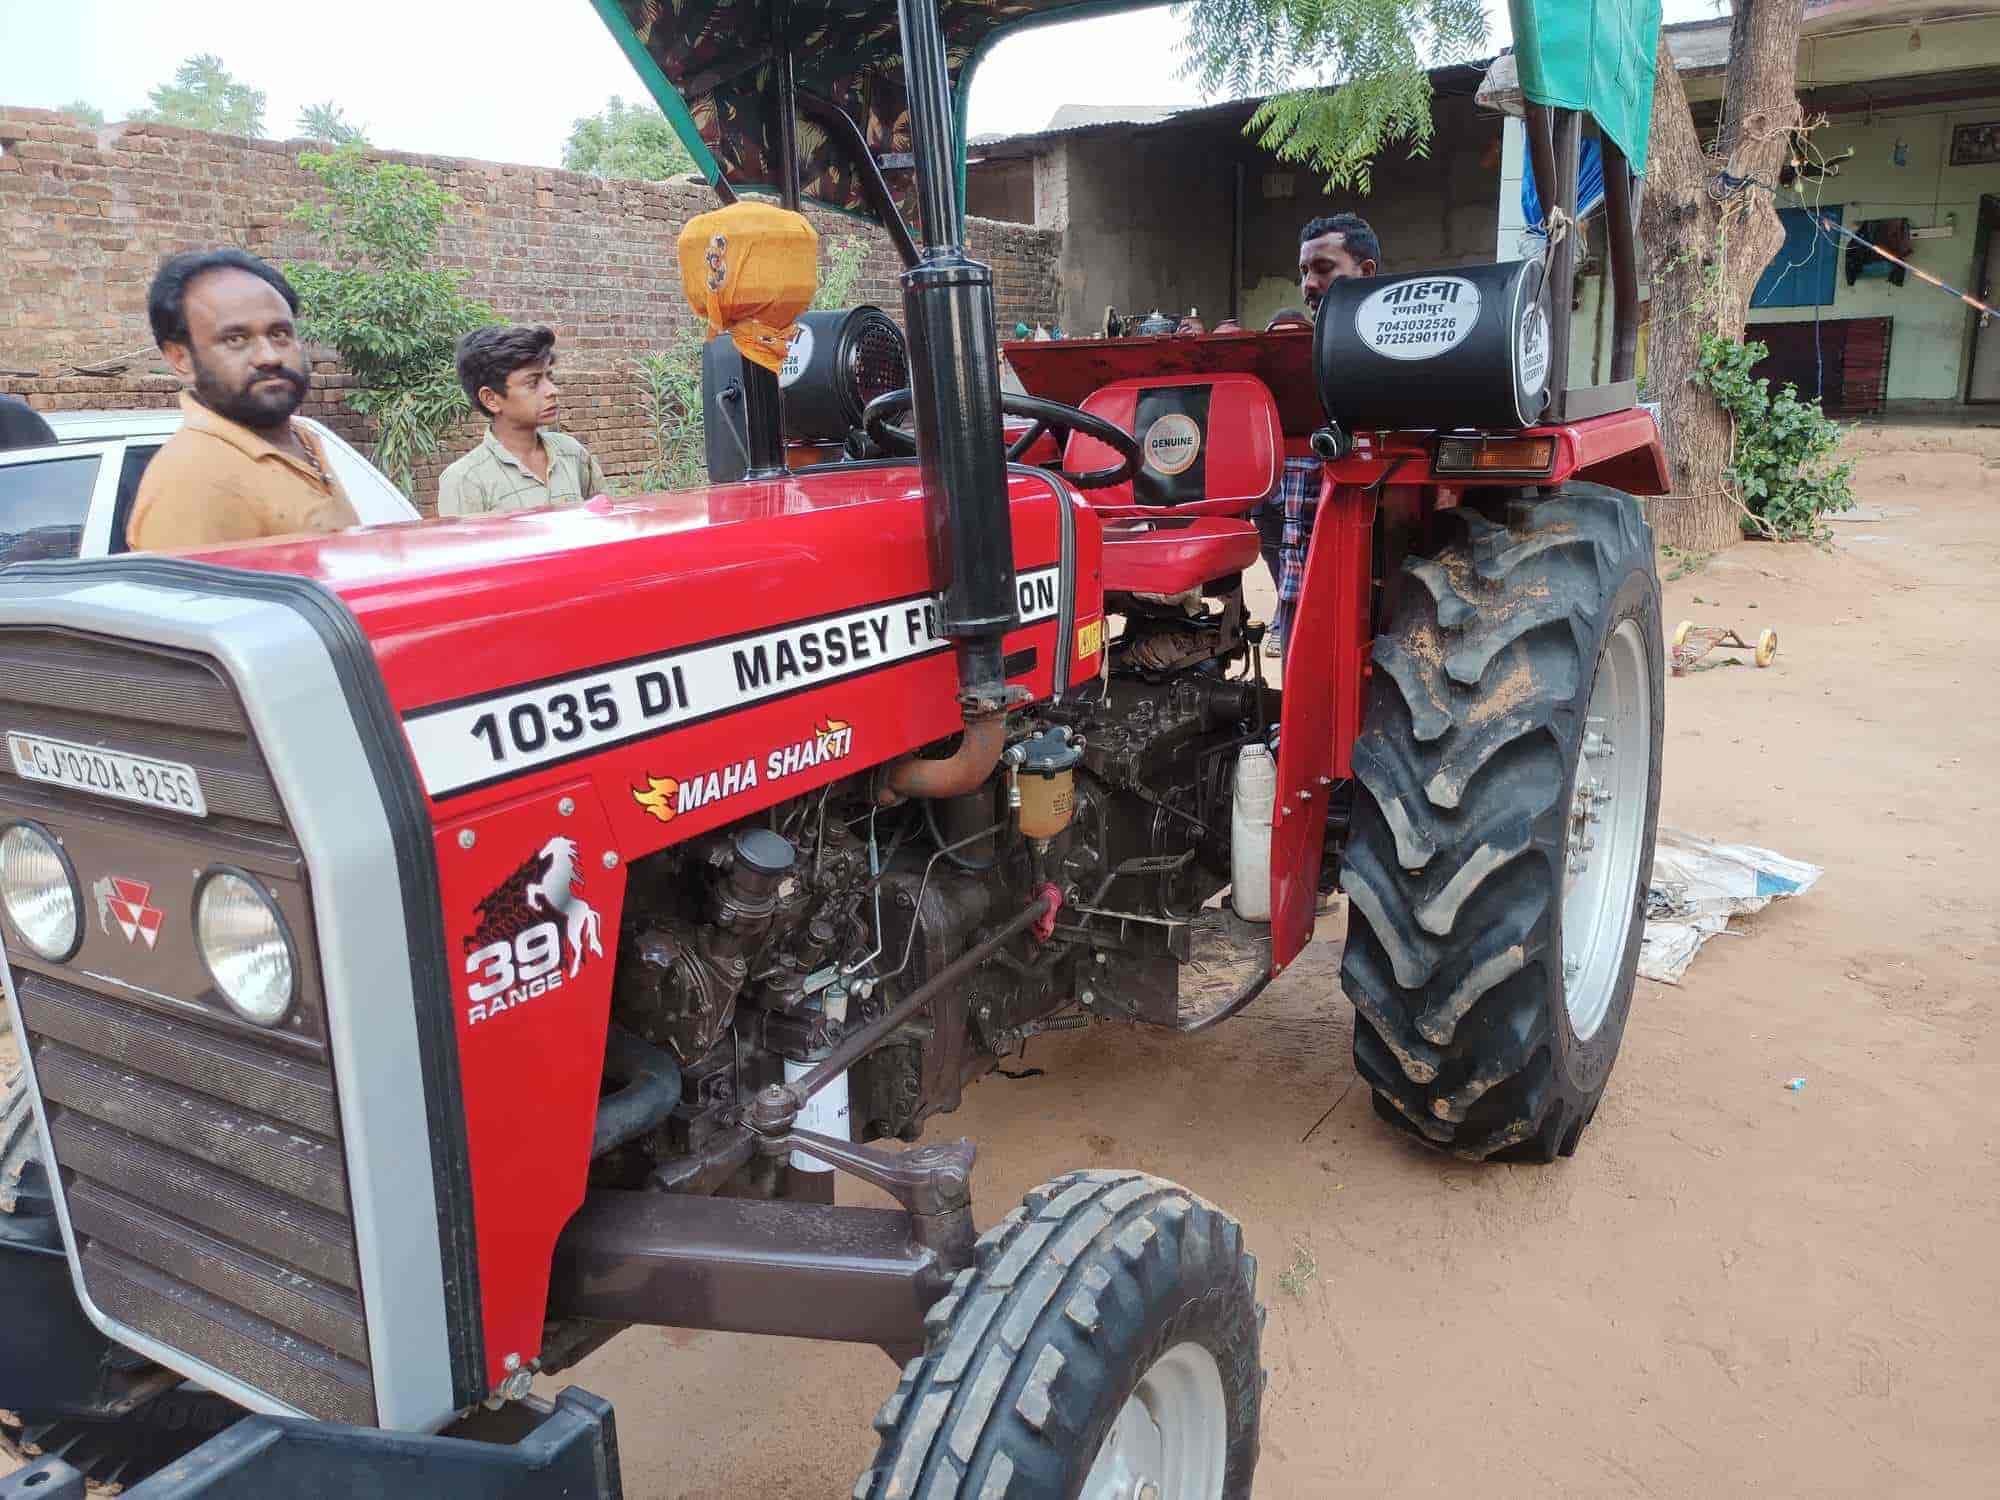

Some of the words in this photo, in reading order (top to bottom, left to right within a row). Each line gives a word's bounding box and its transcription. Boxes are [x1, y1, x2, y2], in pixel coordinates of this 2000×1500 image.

[1375, 331, 1456, 345] 9725290110
[1376, 318, 1456, 333] 7043032526
[1151, 437, 1194, 449] GENUINE
[470, 683, 619, 761] 1035
[635, 665, 690, 719] DI
[732, 614, 889, 691] MASSEY
[677, 758, 758, 815] MAHA
[766, 727, 853, 780] SHAKTI
[465, 921, 561, 1003] 39
[467, 969, 563, 1025] RANGE
